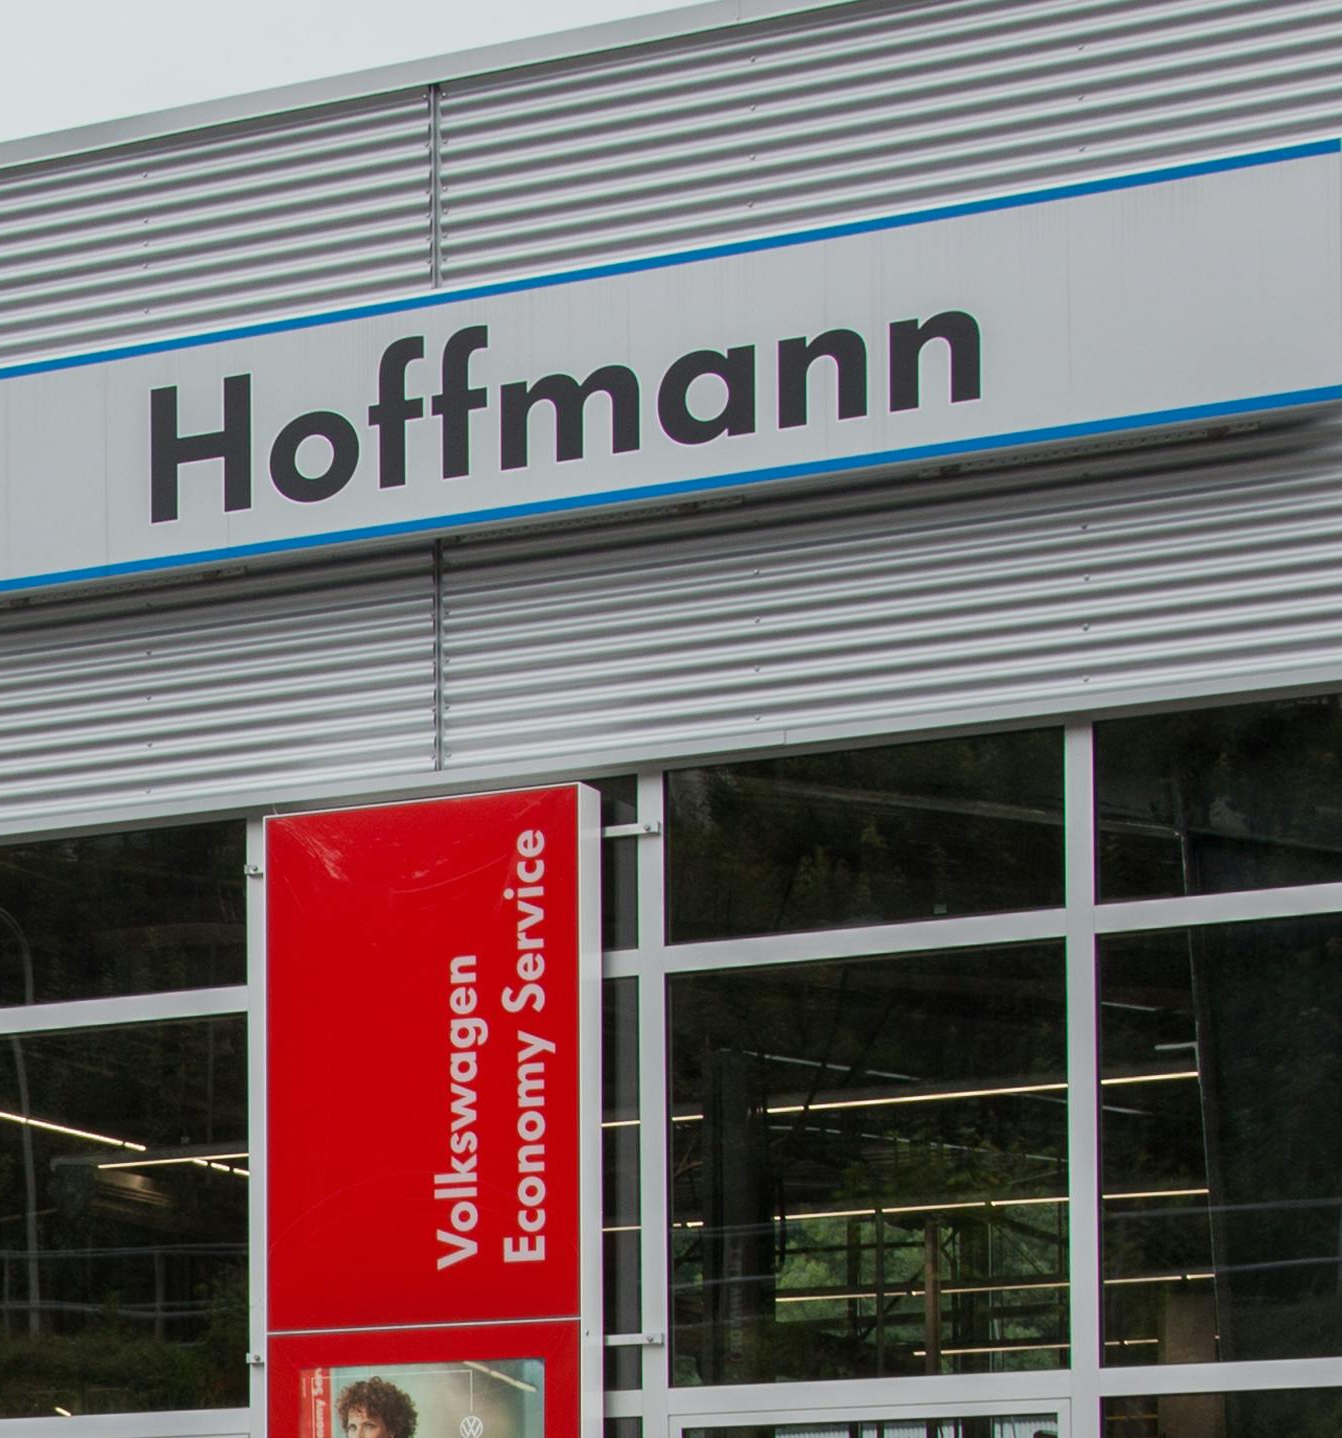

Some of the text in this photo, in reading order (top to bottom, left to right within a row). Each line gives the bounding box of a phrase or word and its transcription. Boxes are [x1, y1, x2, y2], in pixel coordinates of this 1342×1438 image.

[149, 308, 983, 524] Hoffmann
[434, 954, 488, 1271] Volkswagen
[501, 828, 556, 1263] Economy Service
